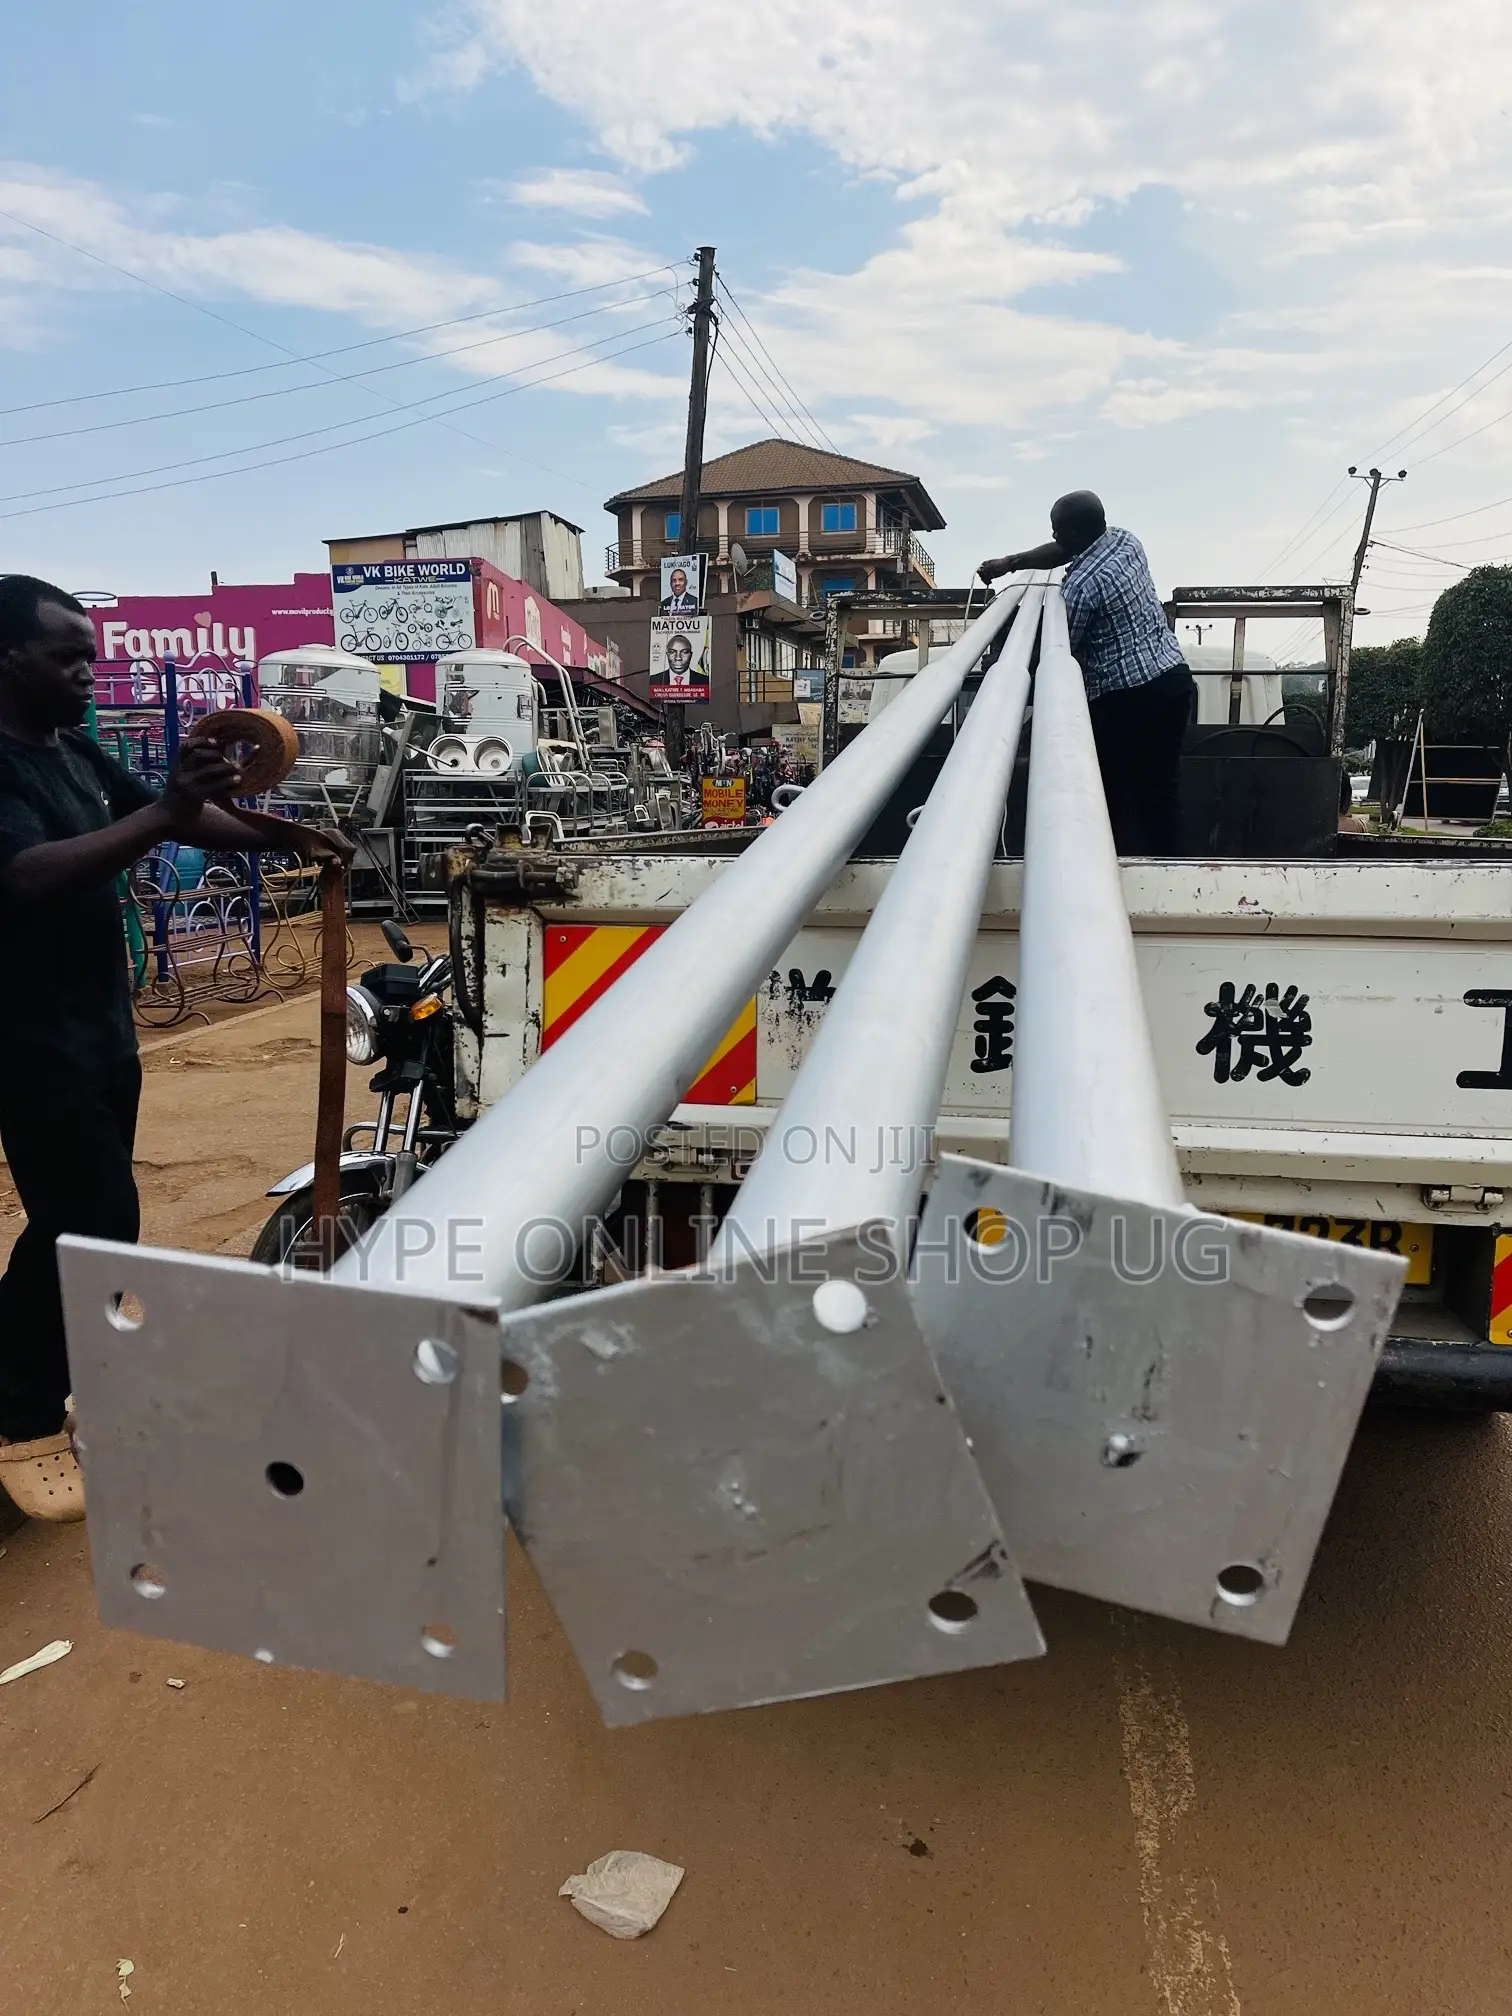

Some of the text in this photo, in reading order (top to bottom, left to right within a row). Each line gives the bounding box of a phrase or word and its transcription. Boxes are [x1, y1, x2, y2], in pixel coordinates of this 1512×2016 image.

[363, 563, 466, 578] VK BIKE WORLD
[652, 620, 700, 631] MATOVU
[102, 621, 256, 675] Family
[704, 788, 744, 798] MOBILE
[704, 799, 744, 808] MONEY
[720, 820, 744, 828] airtel
